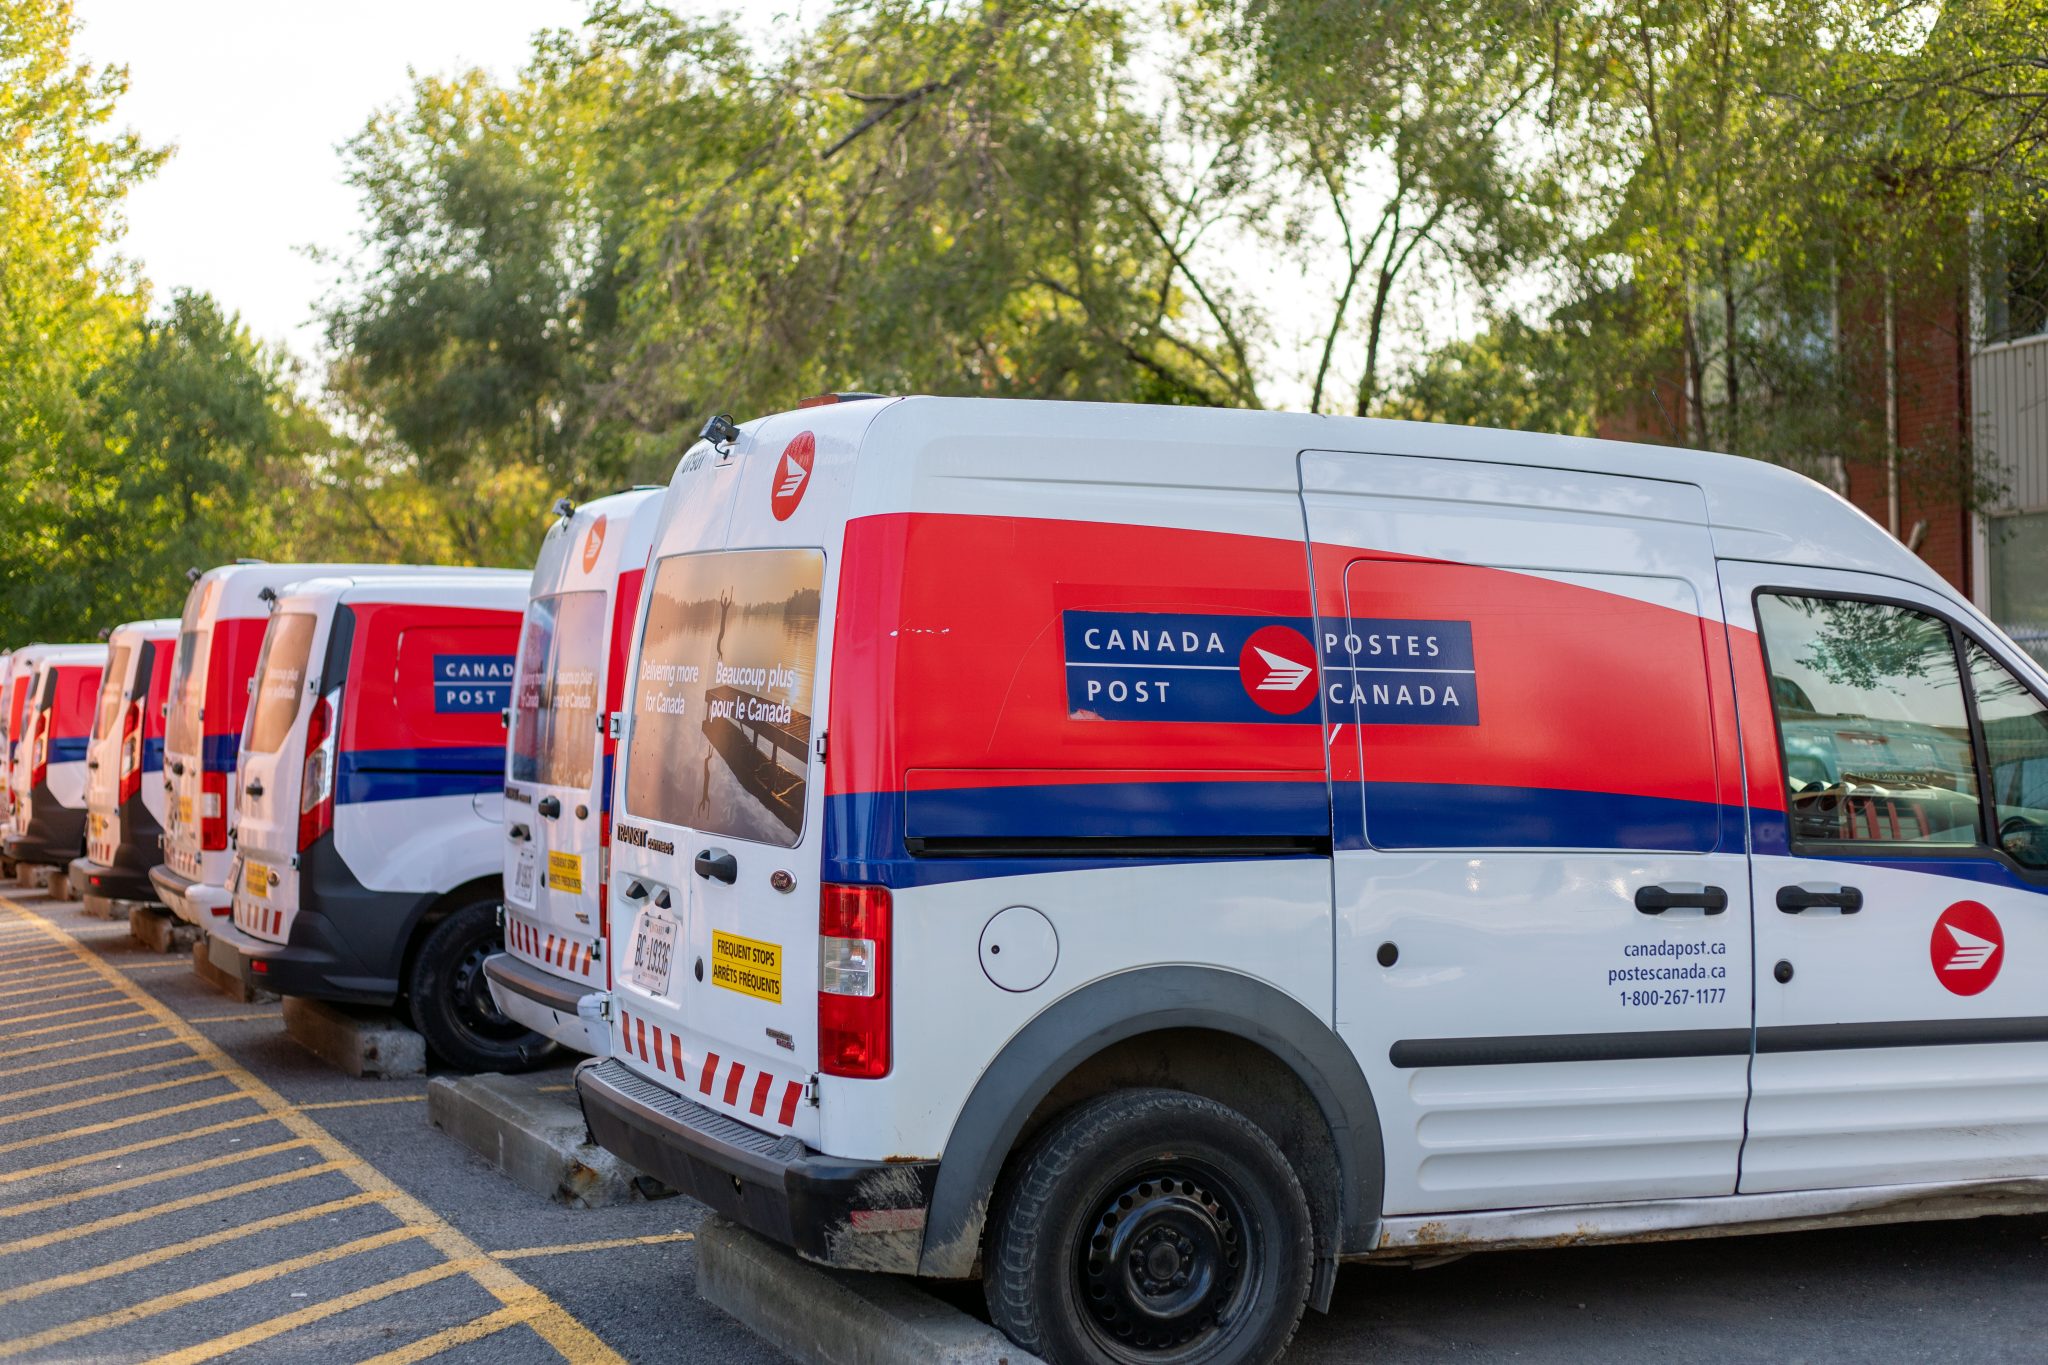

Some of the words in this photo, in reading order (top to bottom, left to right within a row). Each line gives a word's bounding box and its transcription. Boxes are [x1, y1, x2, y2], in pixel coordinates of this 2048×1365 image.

[1084, 629, 1225, 653] CANADA
[1325, 633, 1439, 657] POSTES
[641, 660, 675, 687] Delivering
[676, 664, 699, 684] more
[716, 661, 766, 692] Beaucoup
[768, 662, 794, 692] plus
[447, 690, 496, 705] POST
[645, 690, 657, 713] for
[656, 692, 685, 715] Canada
[1087, 680, 1170, 703] POST
[1328, 683, 1460, 706] CANADA
[710, 698, 736, 722] pour
[735, 695, 746, 720] le
[748, 697, 791, 724] Canada
[617, 823, 648, 848] TRANSIT
[648, 837, 674, 856] connect
[635, 933, 646, 967] BC
[717, 939, 751, 960] FREQUENT
[752, 947, 775, 967] STOPS
[1624, 940, 1726, 959] canadapost.ca
[713, 963, 737, 984] ARRÊTS
[739, 970, 780, 995] FRÉQUENTS
[1608, 963, 1726, 985] postescanada.ca
[1620, 988, 1726, 1006] 1-800-267-1177
